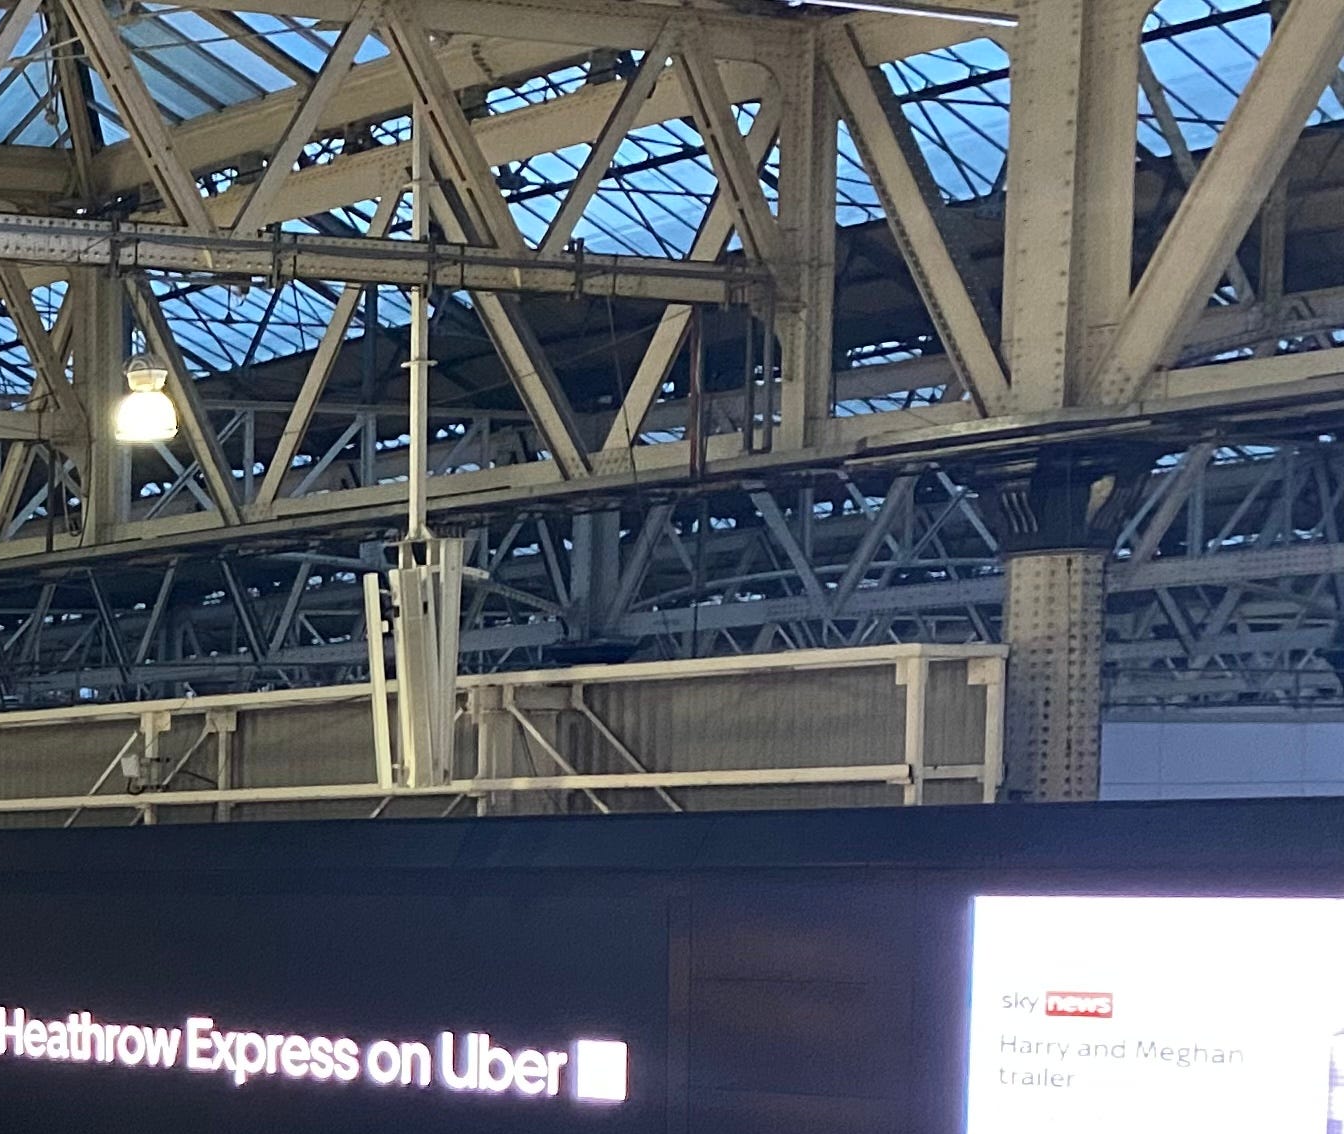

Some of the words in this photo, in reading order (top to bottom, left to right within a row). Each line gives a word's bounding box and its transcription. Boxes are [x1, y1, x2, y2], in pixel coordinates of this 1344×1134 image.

[1002, 991, 1040, 1013] sky
[1047, 996, 1112, 1014] news
[186, 1016, 360, 1087] Express
[367, 1039, 432, 1087] on
[440, 1031, 568, 1096] Uber
[1000, 1034, 1070, 1061] Harry
[1077, 1039, 1126, 1059] and
[1136, 1040, 1244, 1067] Meghan
[999, 1067, 1075, 1087] trailer
